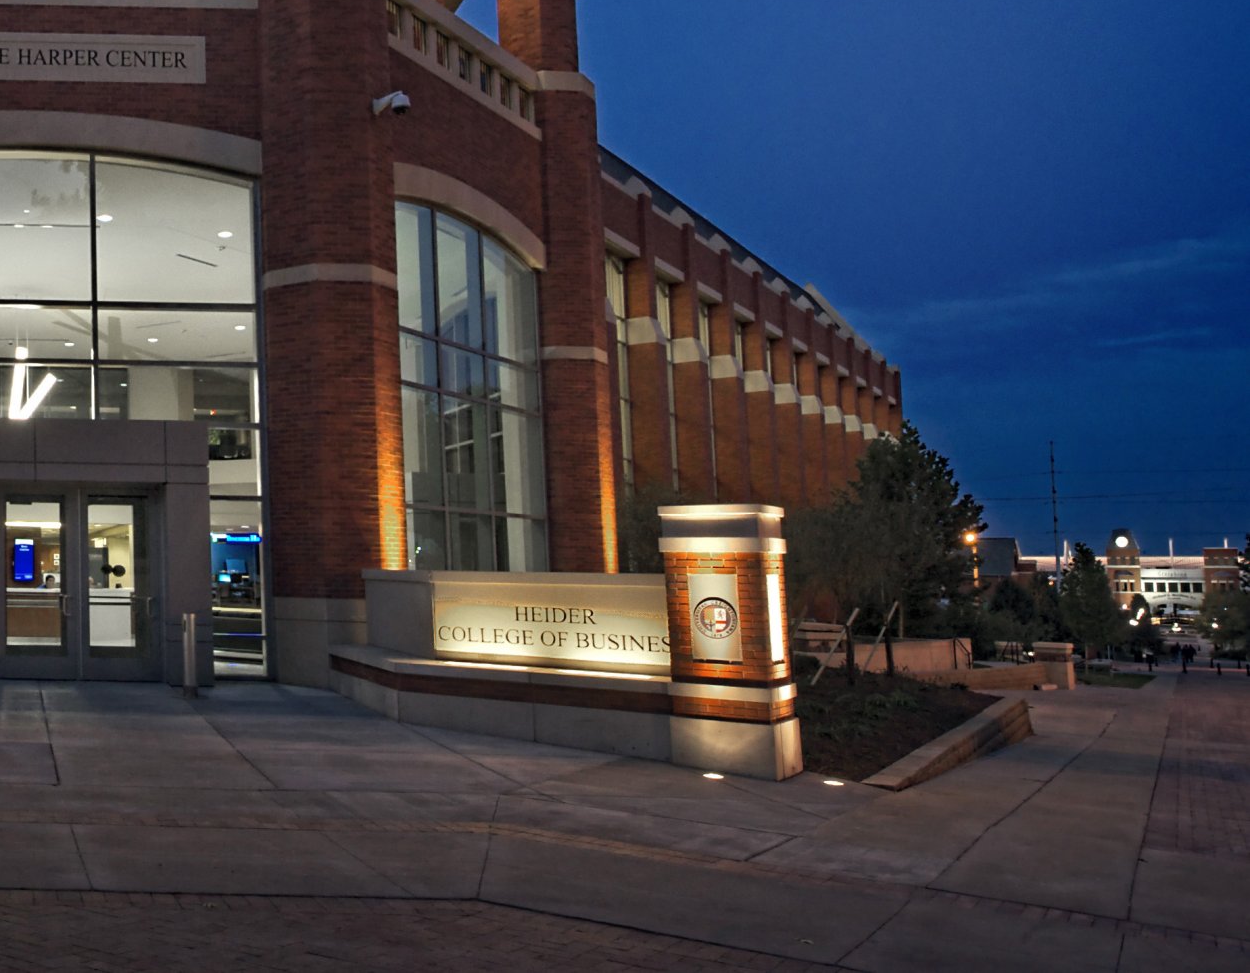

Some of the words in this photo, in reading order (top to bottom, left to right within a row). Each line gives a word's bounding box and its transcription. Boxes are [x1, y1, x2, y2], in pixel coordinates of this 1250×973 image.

[18, 48, 100, 67] HARPER
[105, 49, 188, 69] CENTER
[515, 606, 597, 625] HEIDER
[438, 625, 534, 646] COLLEGE
[540, 630, 569, 647] OF
[575, 632, 670, 653] BUSINES
